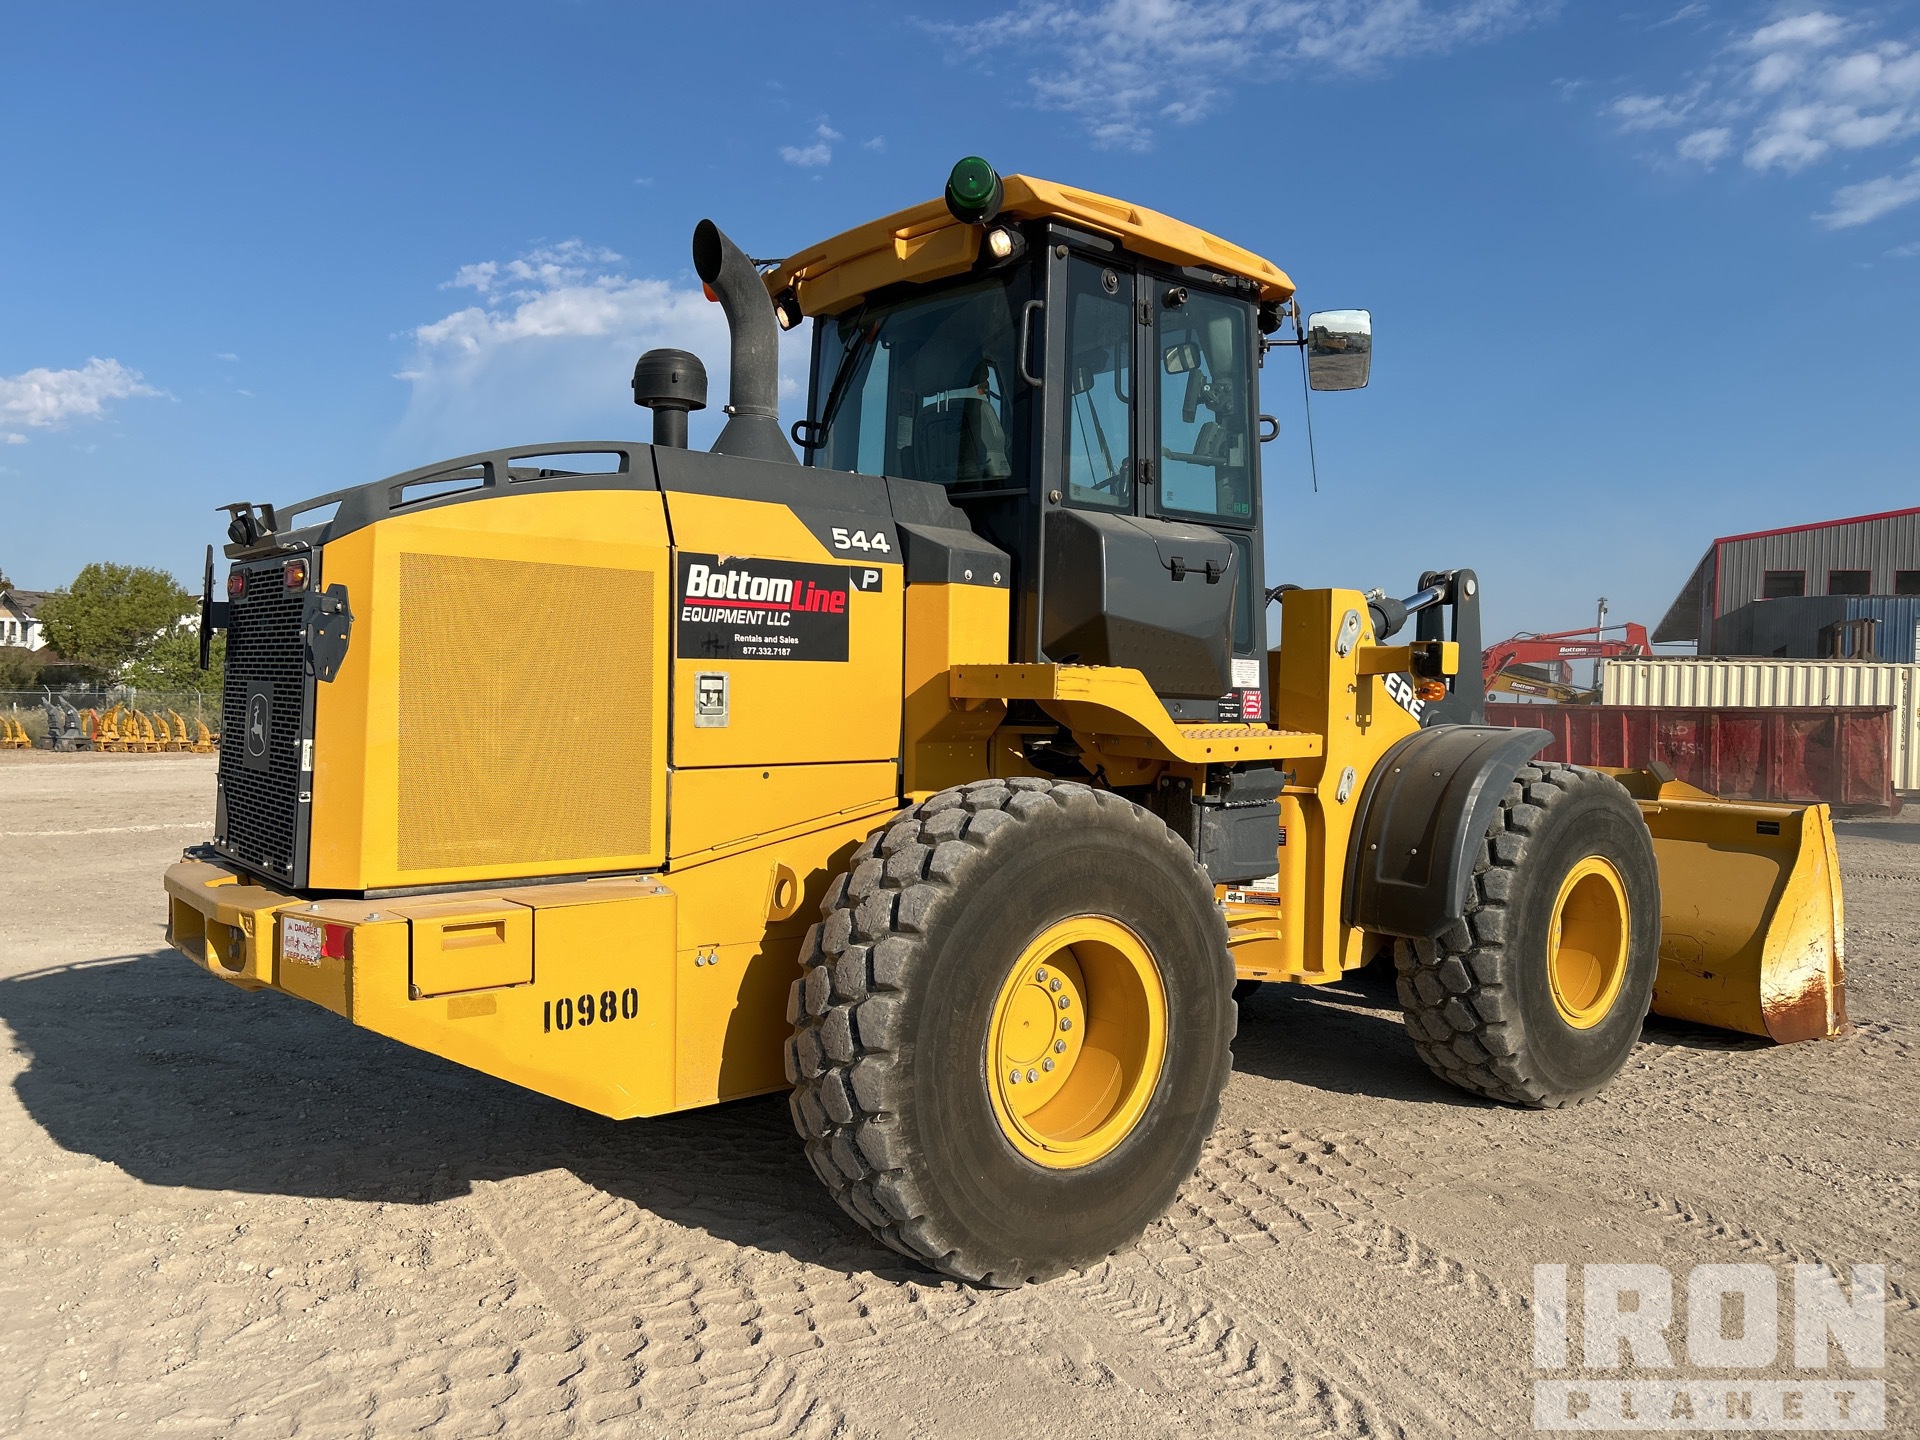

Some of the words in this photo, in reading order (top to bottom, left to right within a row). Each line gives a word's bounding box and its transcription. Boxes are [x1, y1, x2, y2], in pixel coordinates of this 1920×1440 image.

[831, 527, 891, 553] 544
[861, 569, 879, 589] P
[681, 606, 765, 625] EQUIPMENT
[766, 610, 791, 626] LLC
[734, 633, 762, 643] Rentals
[763, 635, 778, 644] and
[779, 635, 799, 644] Sales
[742, 646, 791, 656] 877.332.7187
[1381, 673, 1425, 722] ERE
[294, 923, 319, 937] DANGER
[543, 987, 638, 1034] 10980
